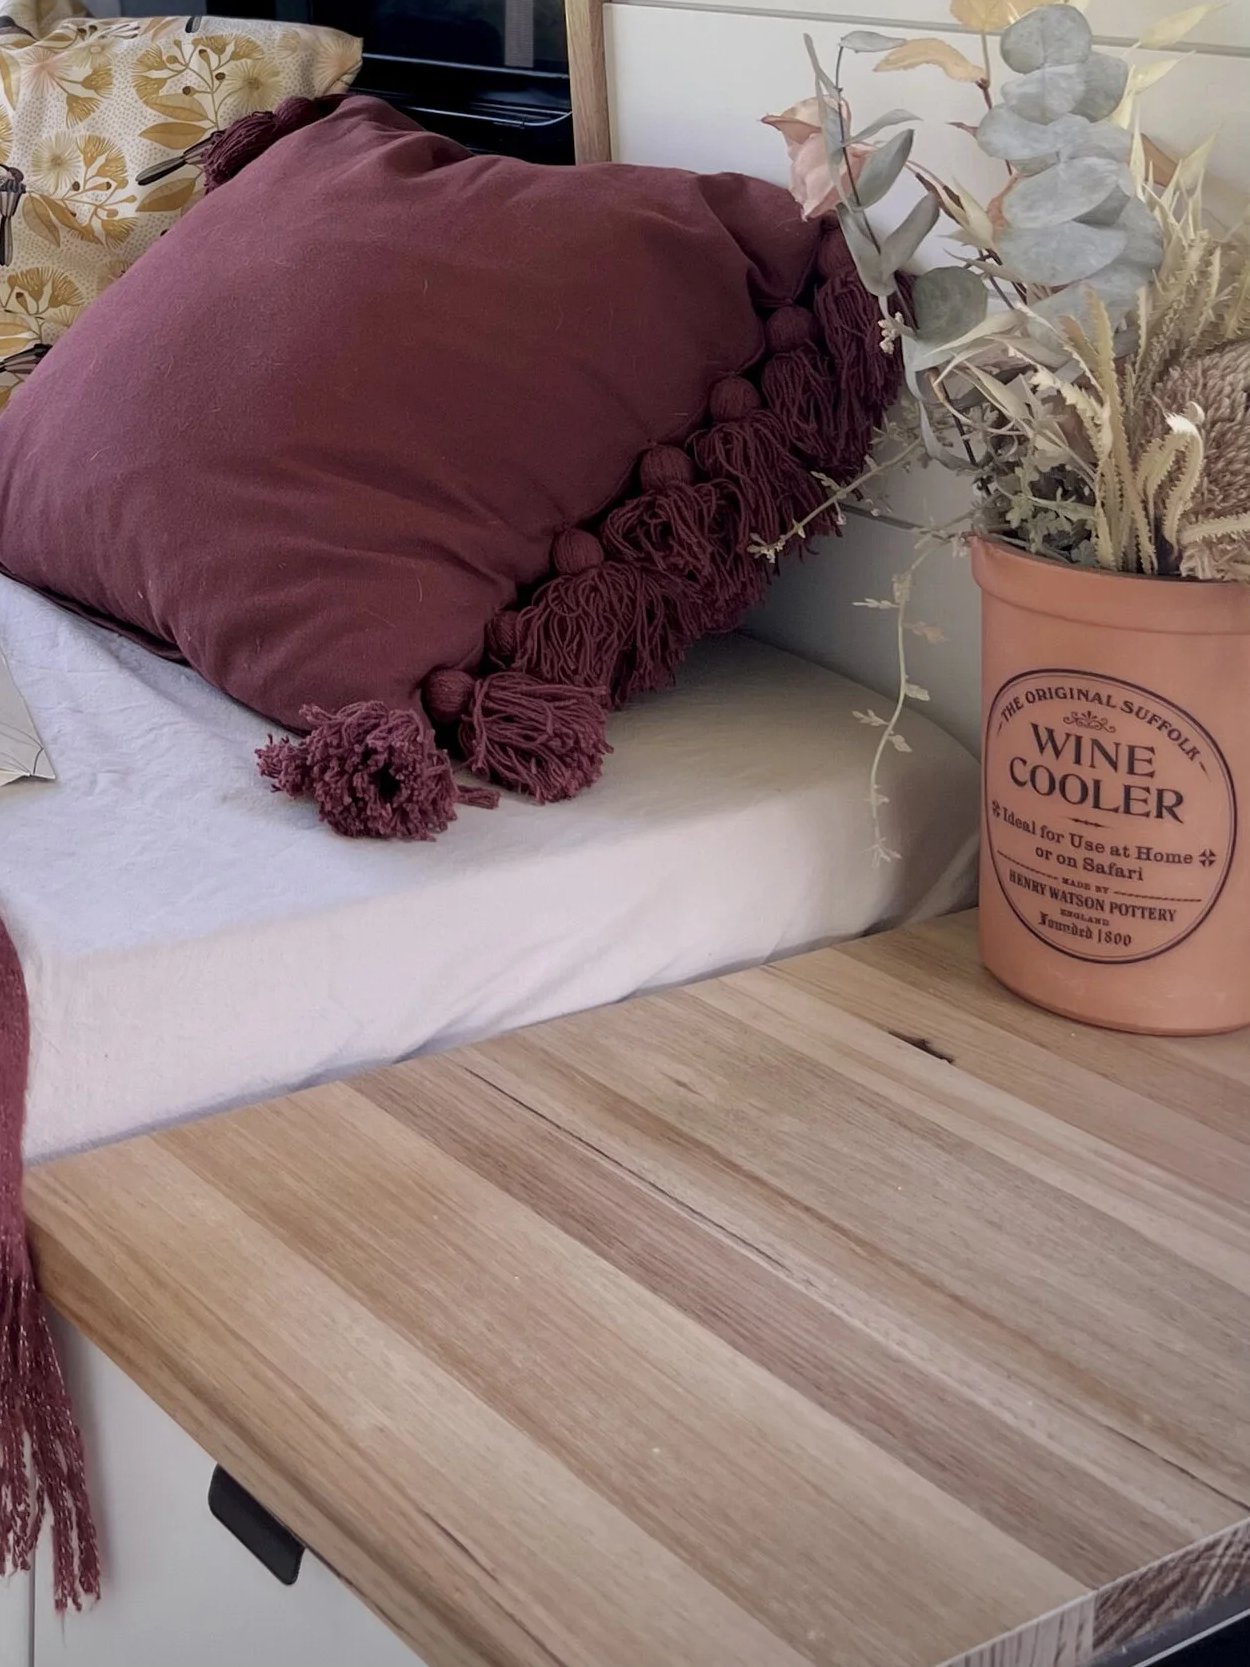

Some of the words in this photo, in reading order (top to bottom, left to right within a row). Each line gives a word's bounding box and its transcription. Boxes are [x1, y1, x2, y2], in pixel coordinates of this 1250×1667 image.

[1001, 696, 1024, 722] THE
[1025, 686, 1117, 709] ORIGINAL
[1120, 700, 1201, 762] SUFFOLK
[1030, 722, 1156, 779] WINE
[1009, 756, 1184, 824] COOLER
[1003, 806, 1036, 836] Ideal
[1040, 824, 1064, 844] for
[1069, 832, 1105, 854] Use
[1109, 845, 1130, 859] at
[1135, 845, 1193, 865] Home
[1035, 846, 1053, 861] or
[1056, 853, 1078, 868] on
[1082, 857, 1144, 881] Safari
[1061, 877, 1091, 891] MADE
[1095, 885, 1110, 895] BY
[1009, 869, 1048, 896] HENRY
[1049, 885, 1105, 912] WATSON
[1109, 901, 1176, 922] POTTERY
[1060, 907, 1110, 926] ENGLAND
[1038, 911, 1093, 939] Founded
[1098, 929, 1132, 947] 1800
